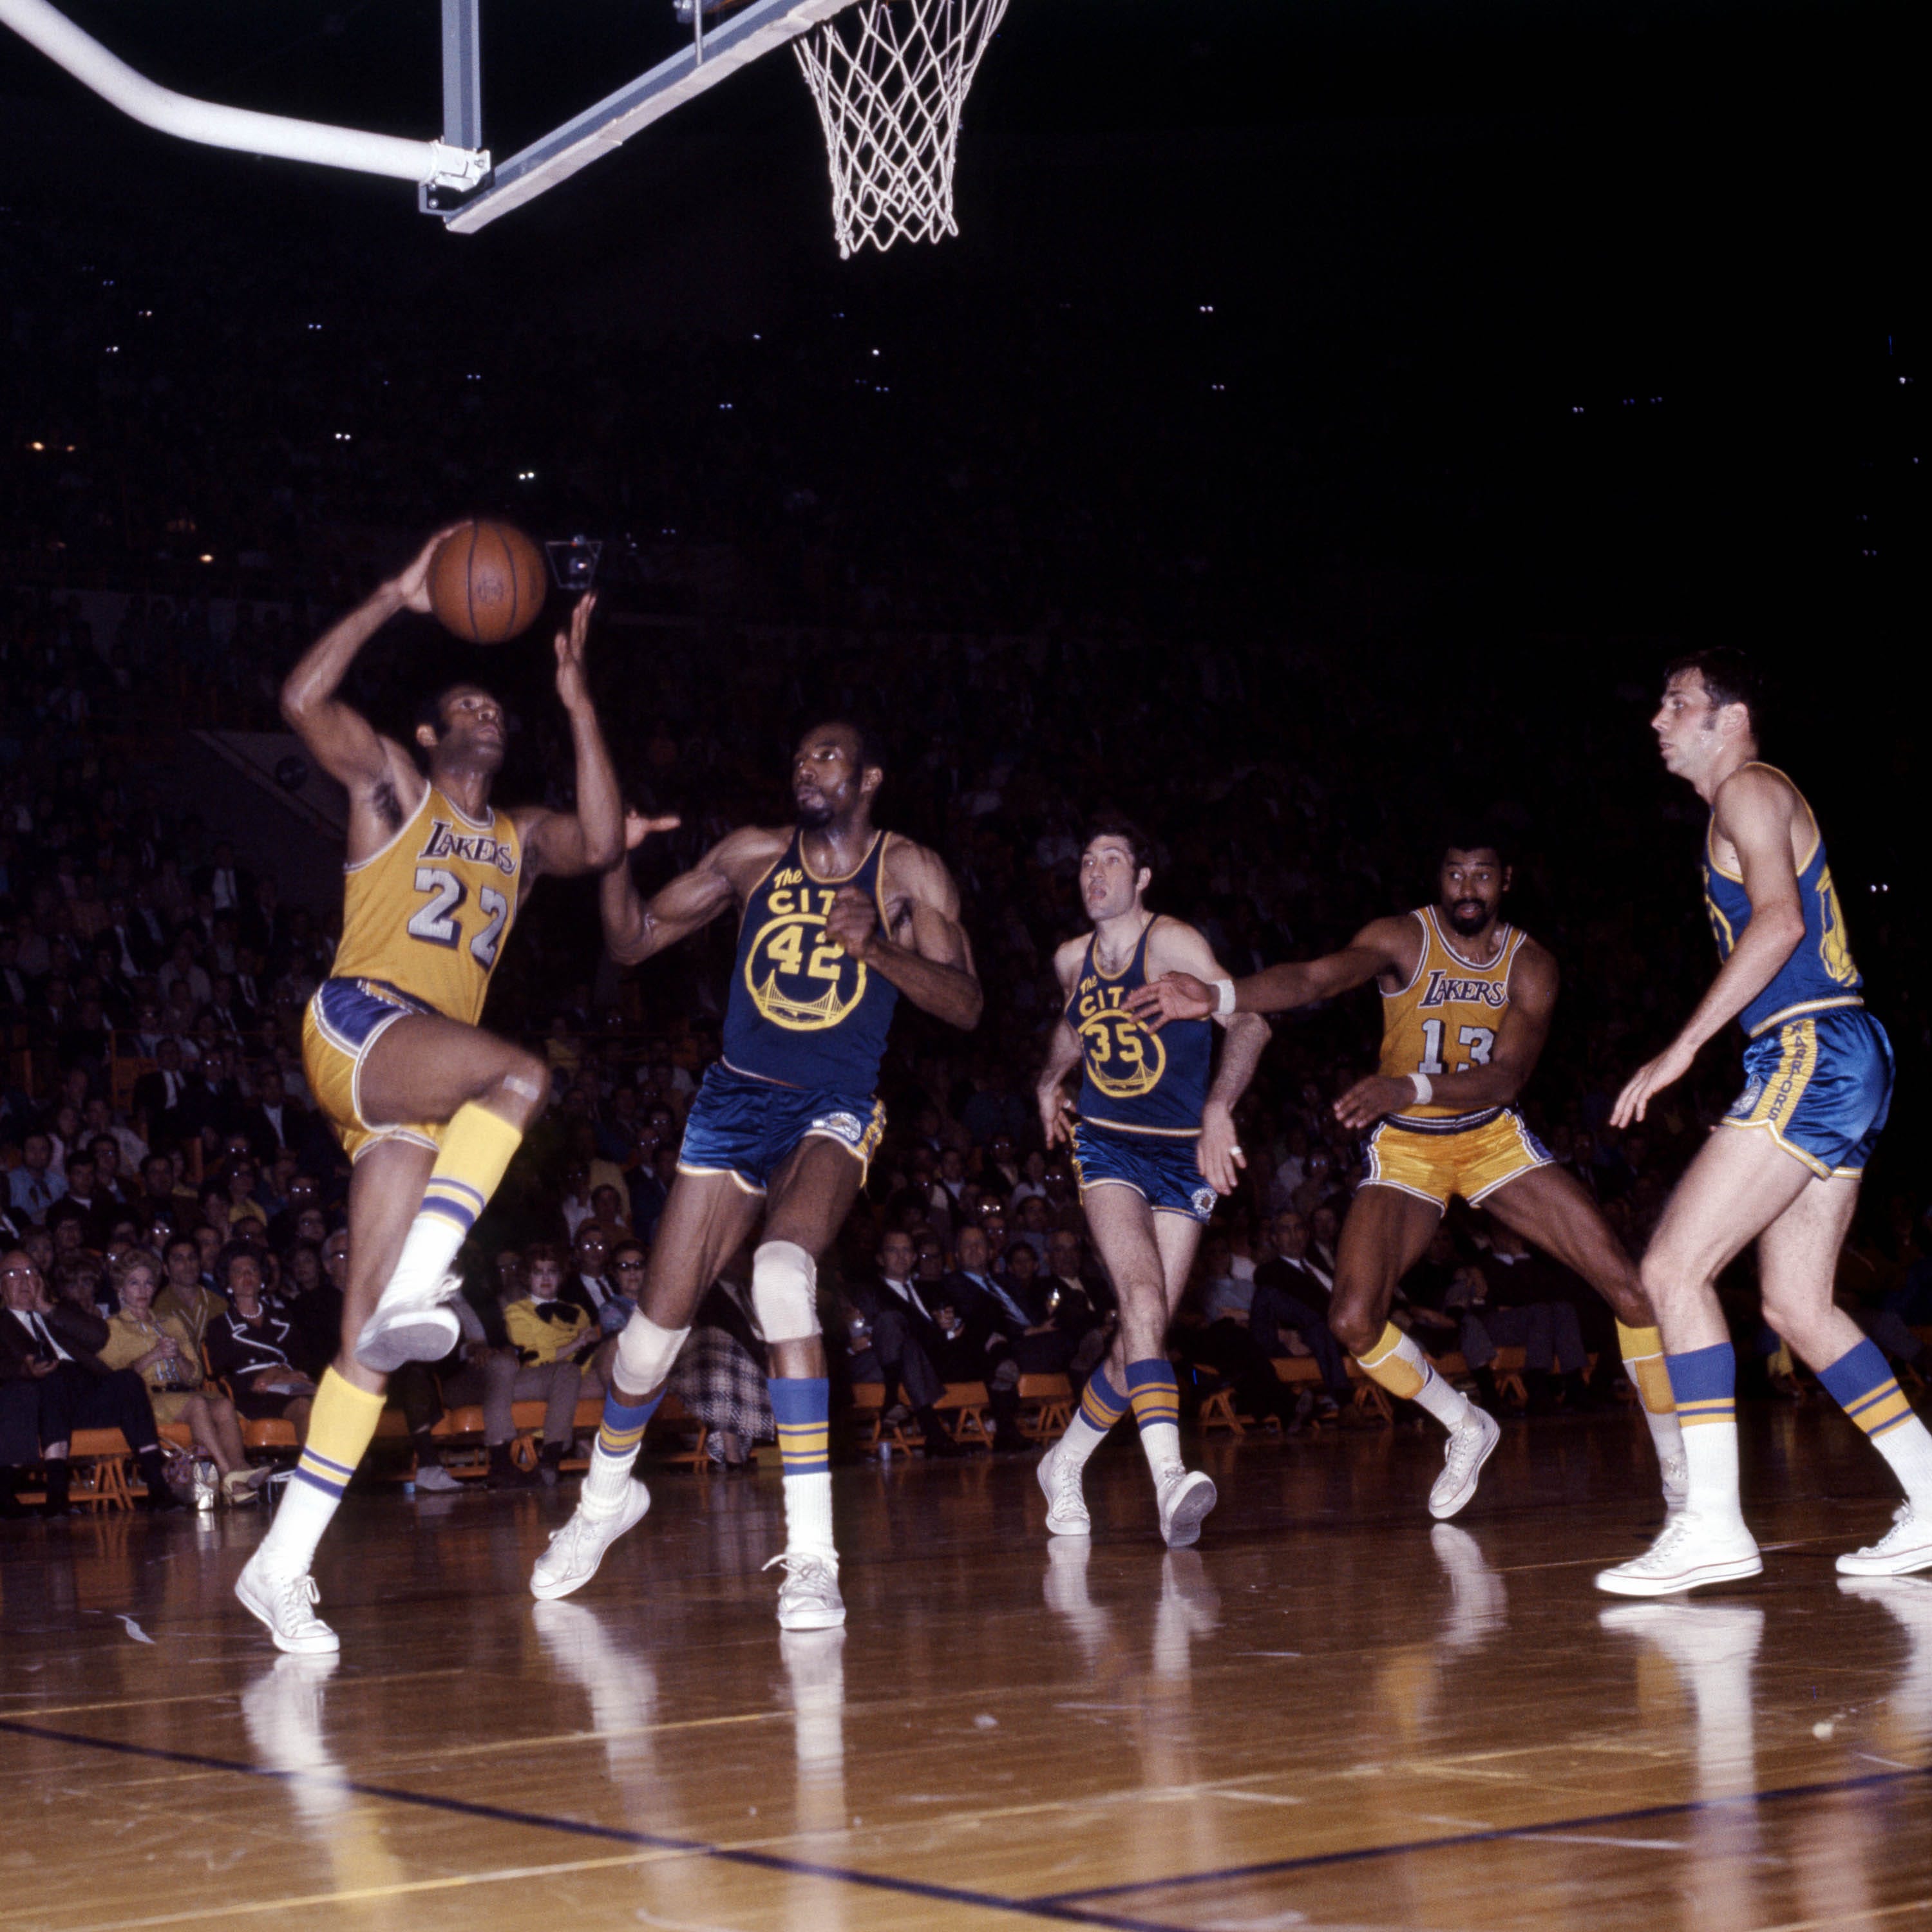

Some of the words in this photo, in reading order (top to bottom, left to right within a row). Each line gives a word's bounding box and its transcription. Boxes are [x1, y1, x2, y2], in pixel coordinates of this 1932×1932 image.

[417, 819, 517, 876] LAKES
[774, 867, 803, 889] The
[408, 867, 507, 973] 22
[768, 888, 836, 916] CIT
[767, 925, 844, 981] 42
[1079, 987, 1133, 1017] CIT
[1080, 975, 1097, 995] The
[1418, 970, 1507, 1009] LAKERS
[1084, 1023, 1144, 1063] 35
[1419, 1018, 1497, 1074] 13
